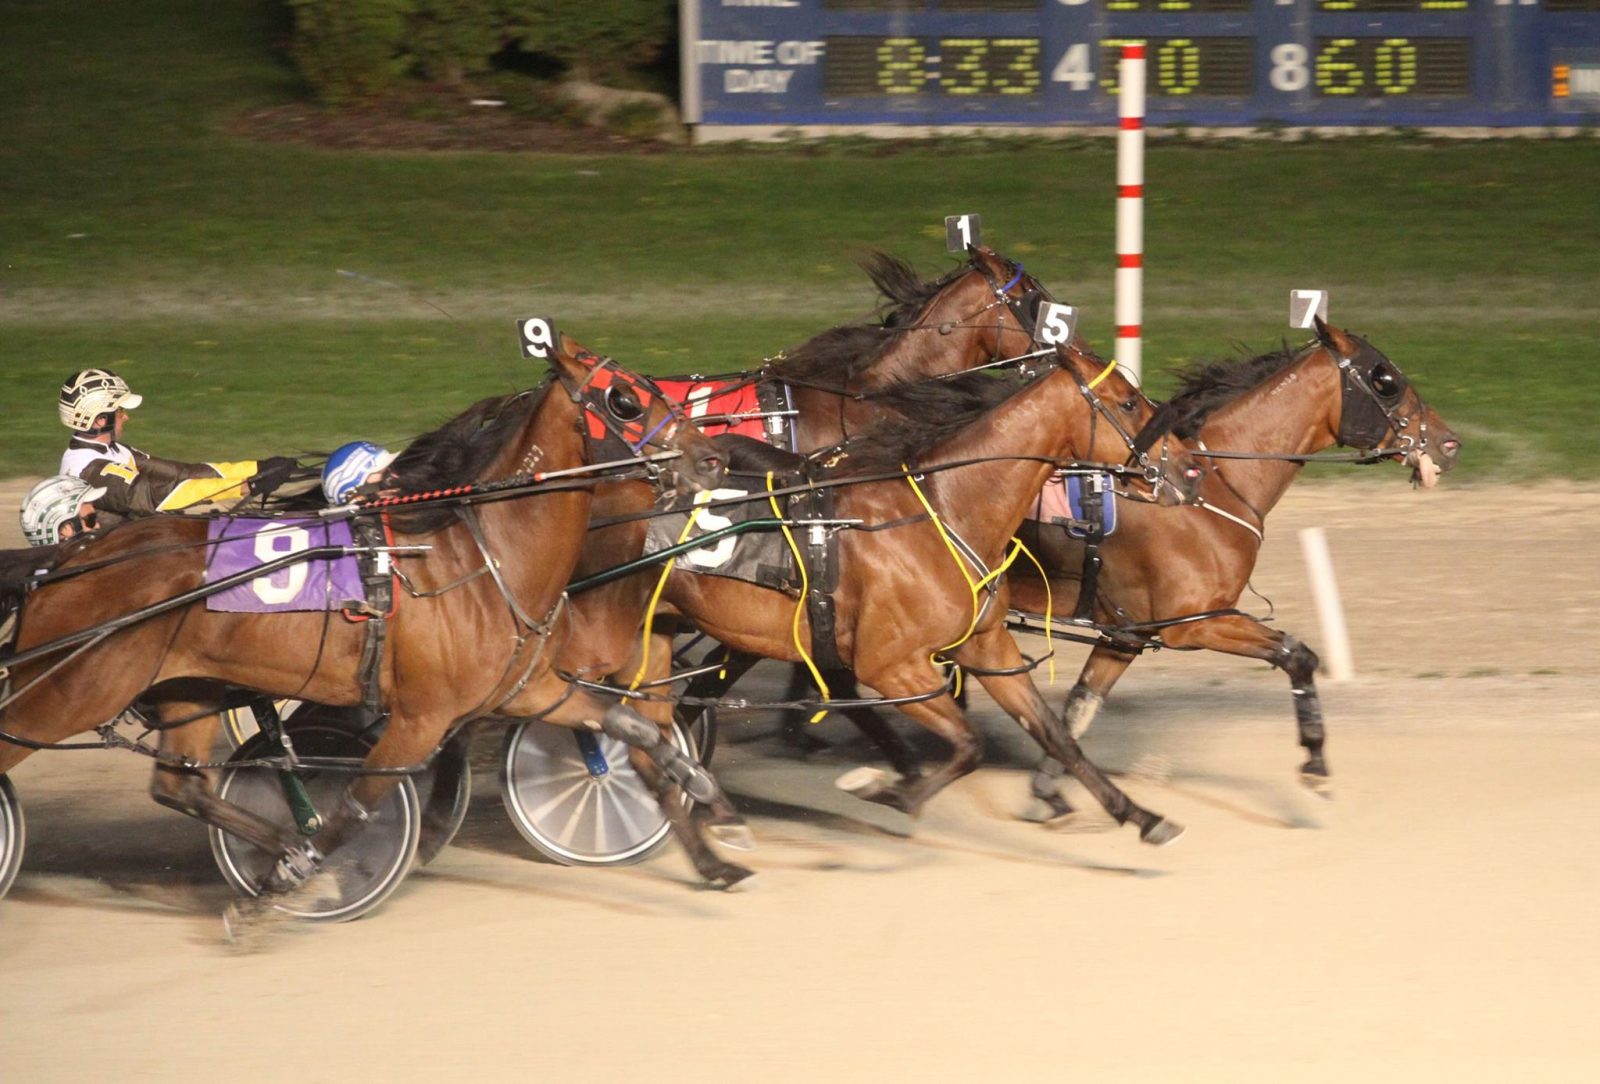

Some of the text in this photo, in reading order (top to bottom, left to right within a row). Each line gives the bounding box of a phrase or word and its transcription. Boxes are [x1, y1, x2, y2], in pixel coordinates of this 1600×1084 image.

[694, 40, 826, 65] TIME OF
[877, 38, 1041, 94] 8:33
[1052, 43, 1095, 90] 4
[1269, 44, 1311, 91] 8
[1315, 38, 1417, 94] 60
[723, 69, 796, 93] DAY
[957, 215, 971, 250] 1
[1042, 304, 1073, 344] 5
[1297, 290, 1321, 328] 7
[523, 317, 553, 358] 9
[684, 488, 748, 568] 5
[252, 522, 309, 604] 9
